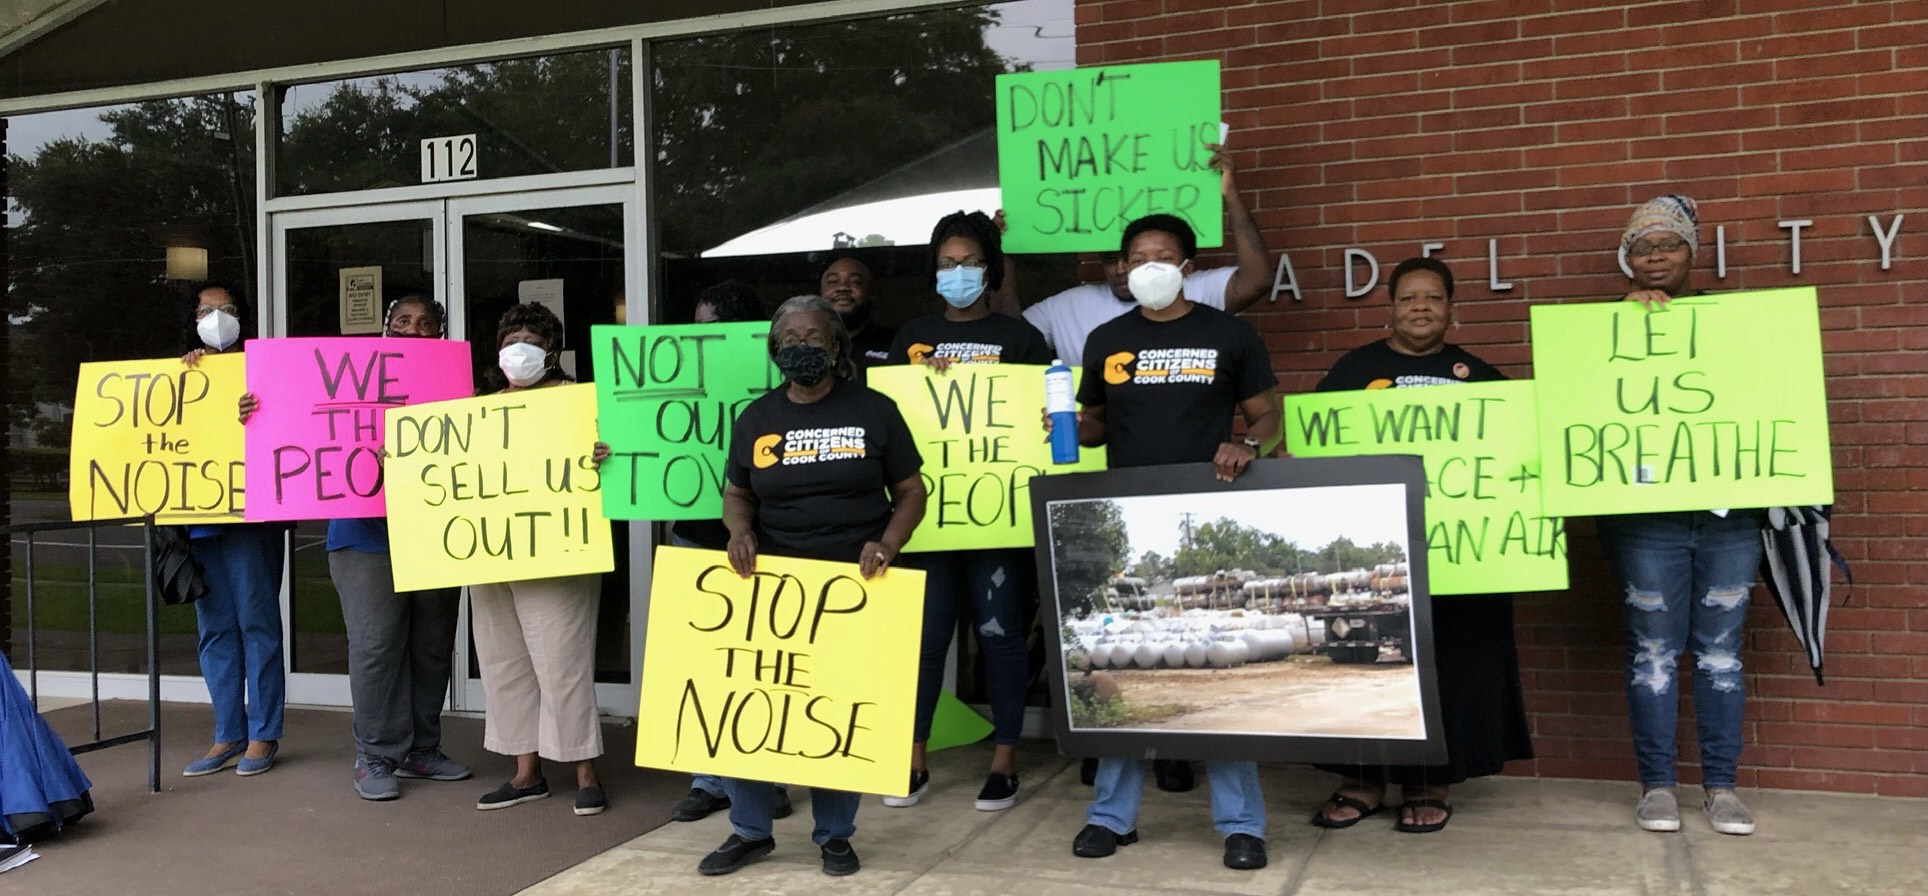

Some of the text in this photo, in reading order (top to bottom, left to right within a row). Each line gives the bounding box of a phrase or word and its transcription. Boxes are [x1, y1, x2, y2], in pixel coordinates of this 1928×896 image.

[1009, 71, 1131, 133] DON'T
[427, 138, 475, 179] 112
[1037, 121, 1218, 181] MAKE US
[1032, 183, 1206, 239] SICKER
[1270, 238, 1514, 302] ADL
[934, 349, 1001, 358] CITIZENS
[936, 342, 1003, 352] CONCERNED
[1138, 348, 1218, 360] CONCERNED
[1608, 302, 1719, 363] LET
[314, 348, 410, 403] WE
[612, 333, 784, 394] NOT I
[1133, 374, 1215, 385] COOK COUNTY
[1136, 358, 1217, 371] CITIZENS
[1395, 375, 1466, 385] CONCERN
[94, 369, 210, 428] STOP
[925, 373, 1015, 435] WE
[1616, 371, 1715, 415] US
[141, 432, 190, 455] the
[312, 409, 378, 442] TH
[396, 404, 527, 458] DON'T
[784, 436, 866, 452] CITIZENS
[785, 426, 866, 441] CONCERNED
[1297, 397, 1506, 447] WE WANT
[273, 445, 385, 505] PEO
[782, 455, 817, 465] COOK
[928, 436, 1018, 469] THE
[1564, 420, 1807, 488] BREATHE
[90, 459, 246, 520] NOISE
[421, 454, 602, 507] SELL US
[920, 465, 1046, 529] EOP
[443, 507, 589, 560] OUT!!
[1427, 516, 1490, 565] AN
[689, 565, 868, 644] STOP
[715, 647, 812, 689] THE
[671, 678, 878, 765] NOISE
